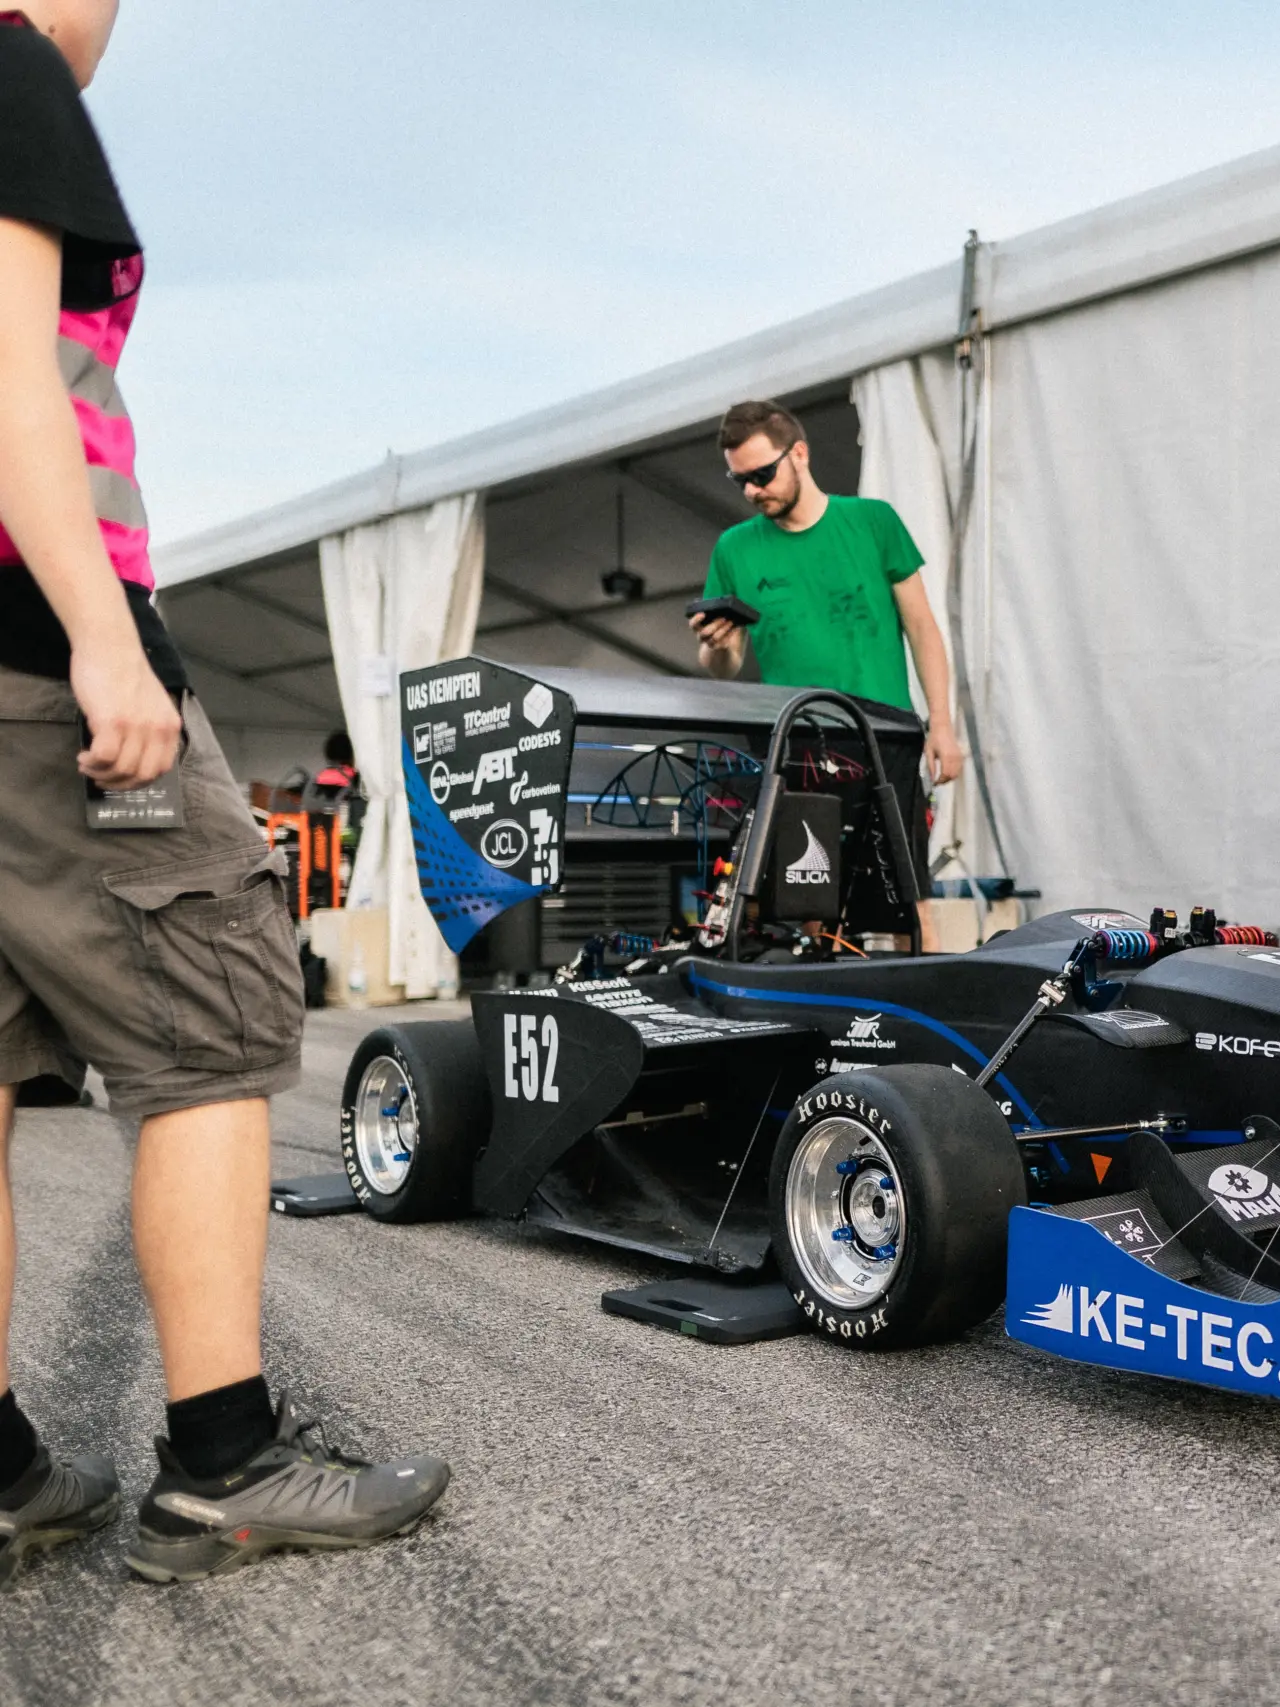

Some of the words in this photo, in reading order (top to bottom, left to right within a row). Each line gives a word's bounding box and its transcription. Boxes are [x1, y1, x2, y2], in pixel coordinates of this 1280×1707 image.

[407, 683, 428, 711] UAS
[429, 671, 480, 705] KEMPTEN
[464, 702, 511, 731] TTControl
[519, 729, 561, 752] CODESYS
[472, 747, 518, 795] ABT
[522, 782, 561, 799] carbovation
[492, 831, 517, 857] JCL
[504, 1013, 559, 1103] E52
[877, 1039, 896, 1049] GmbH
[1079, 1285, 1274, 1379] KE-TEC
